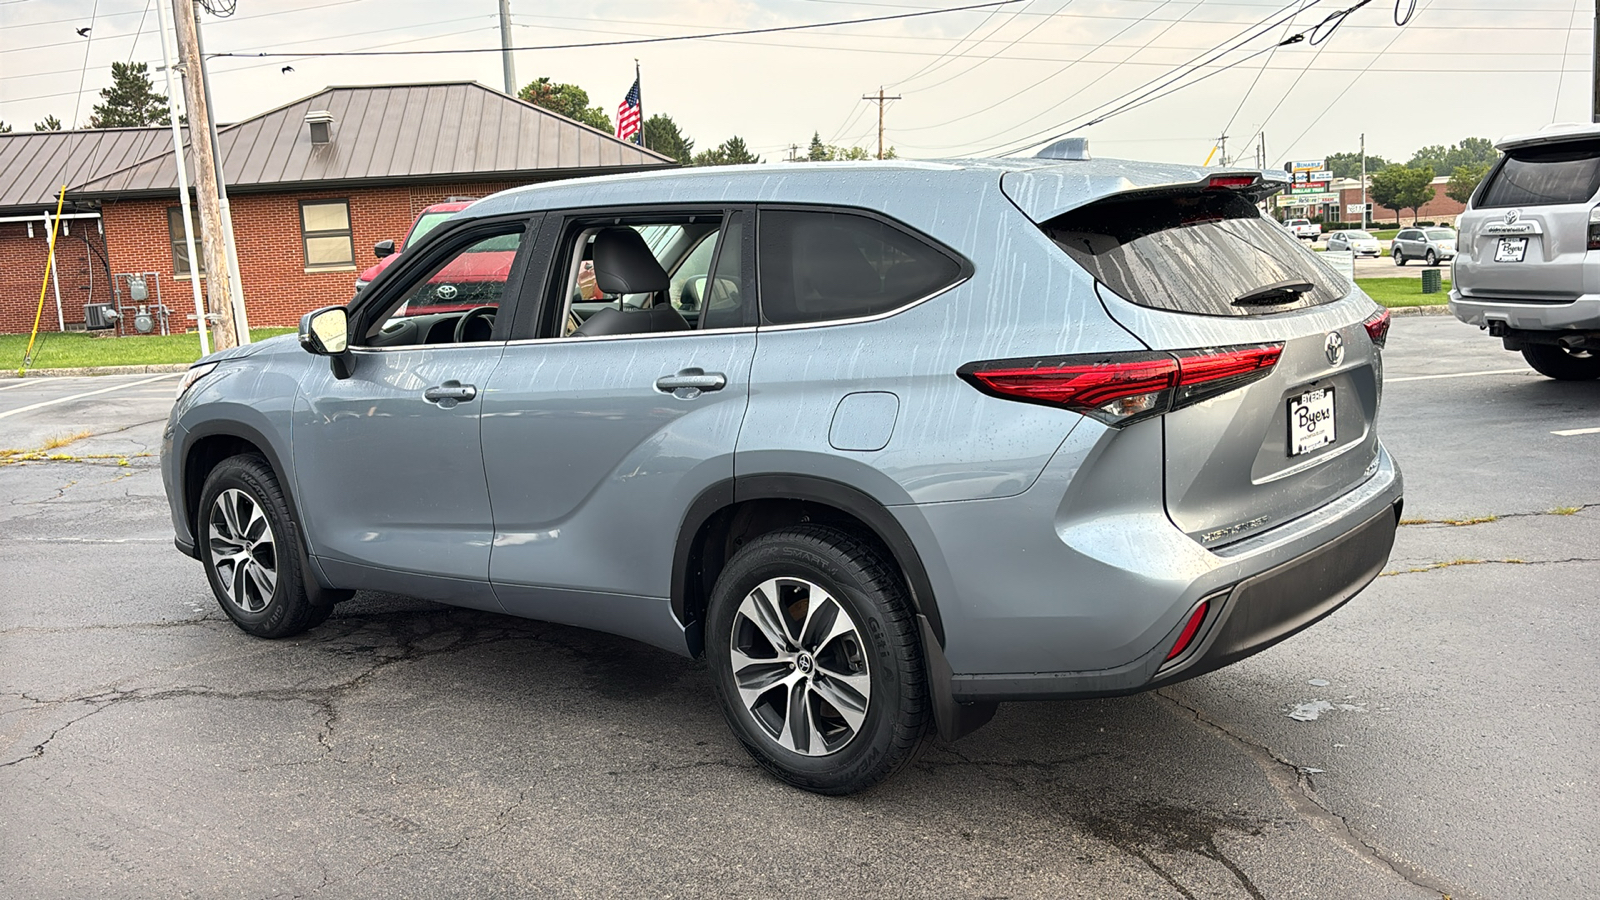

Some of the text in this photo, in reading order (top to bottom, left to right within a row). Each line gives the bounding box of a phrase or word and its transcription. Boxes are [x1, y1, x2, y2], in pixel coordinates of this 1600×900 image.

[1302, 389, 1325, 403] BYERS
[1294, 406, 1330, 432] Byers
[241, 471, 278, 521] WEATHER
[782, 546, 830, 568] SMART
